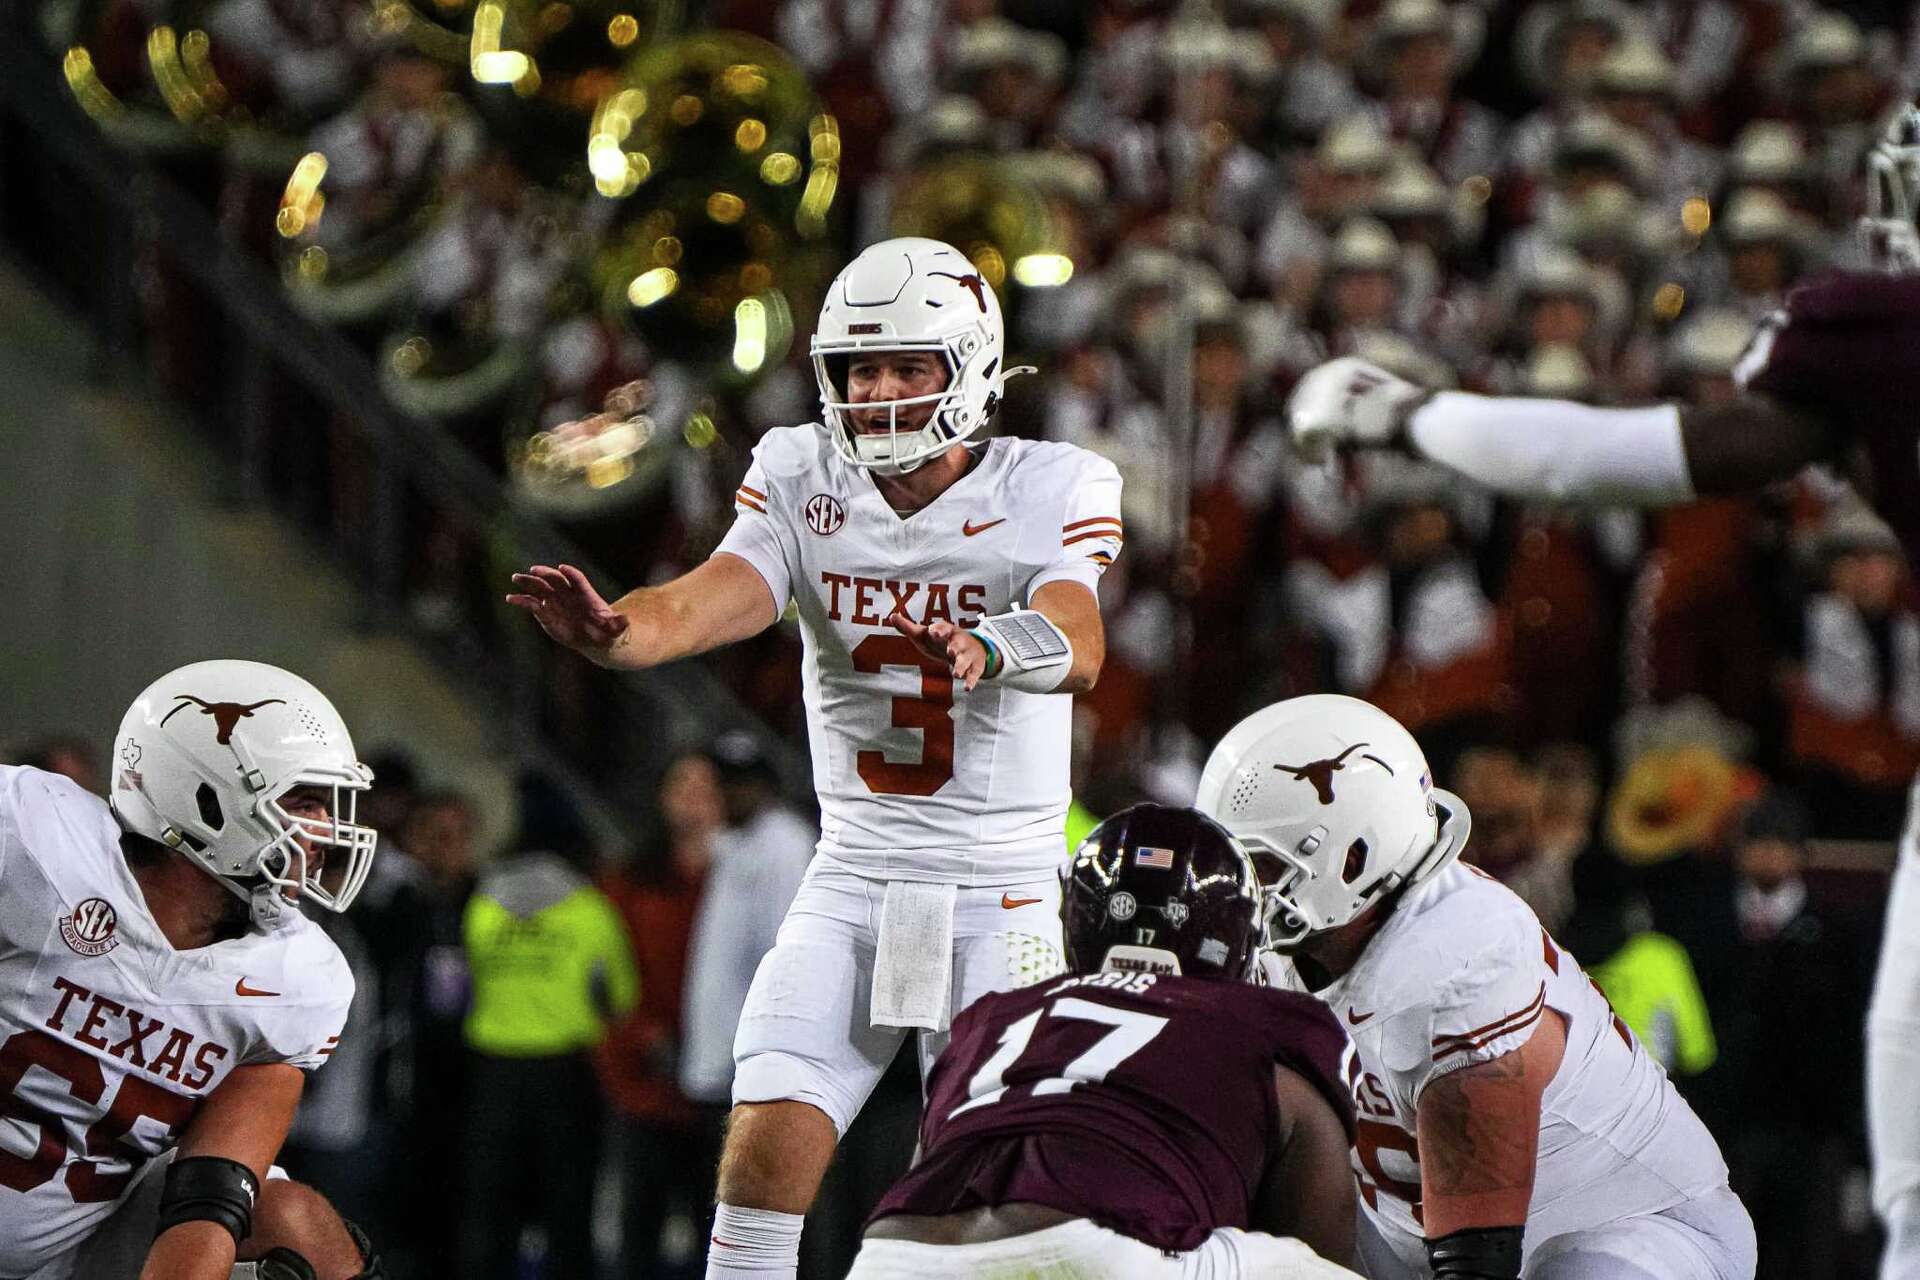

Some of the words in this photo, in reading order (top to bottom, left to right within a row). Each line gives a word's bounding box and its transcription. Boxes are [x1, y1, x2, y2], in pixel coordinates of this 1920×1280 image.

[805, 494, 844, 535] SEC
[821, 571, 987, 629] TEXAS
[851, 634, 955, 797] 3
[74, 898, 116, 942] SEC
[1111, 893, 1135, 919] SEC
[63, 926, 108, 954] GRADUATE
[1136, 927, 1156, 945] 17
[1110, 957, 1147, 972] TEXAS
[46, 975, 229, 1090] TEXAS
[948, 997, 1171, 1121] 17
